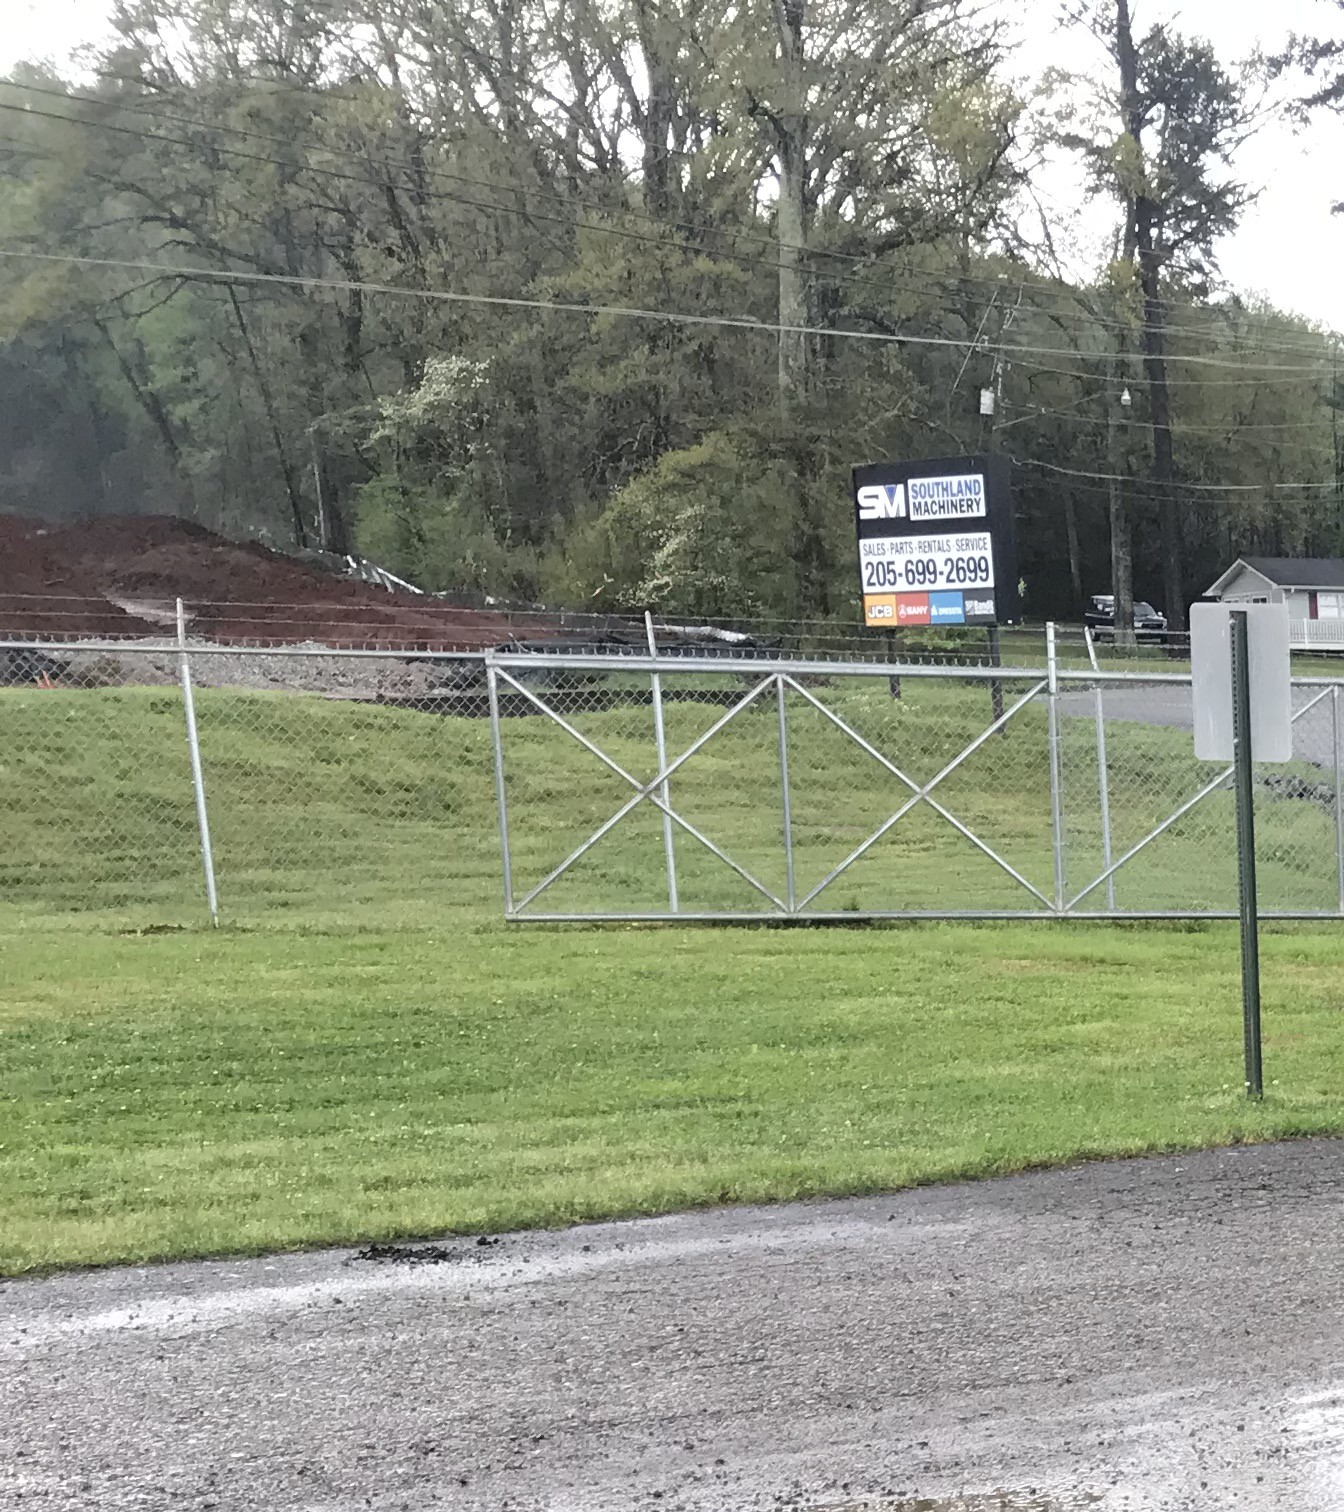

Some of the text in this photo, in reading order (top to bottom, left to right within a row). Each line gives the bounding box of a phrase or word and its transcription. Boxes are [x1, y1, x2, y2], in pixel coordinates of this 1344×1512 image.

[911, 479, 981, 499] SOUTHLAND
[857, 484, 906, 520] SM
[912, 498, 982, 516] MACHINERY
[863, 537, 988, 557] SALES PARTS RENTALS SERVICE
[865, 555, 989, 587] 205-699-2699
[868, 605, 893, 618] JCB
